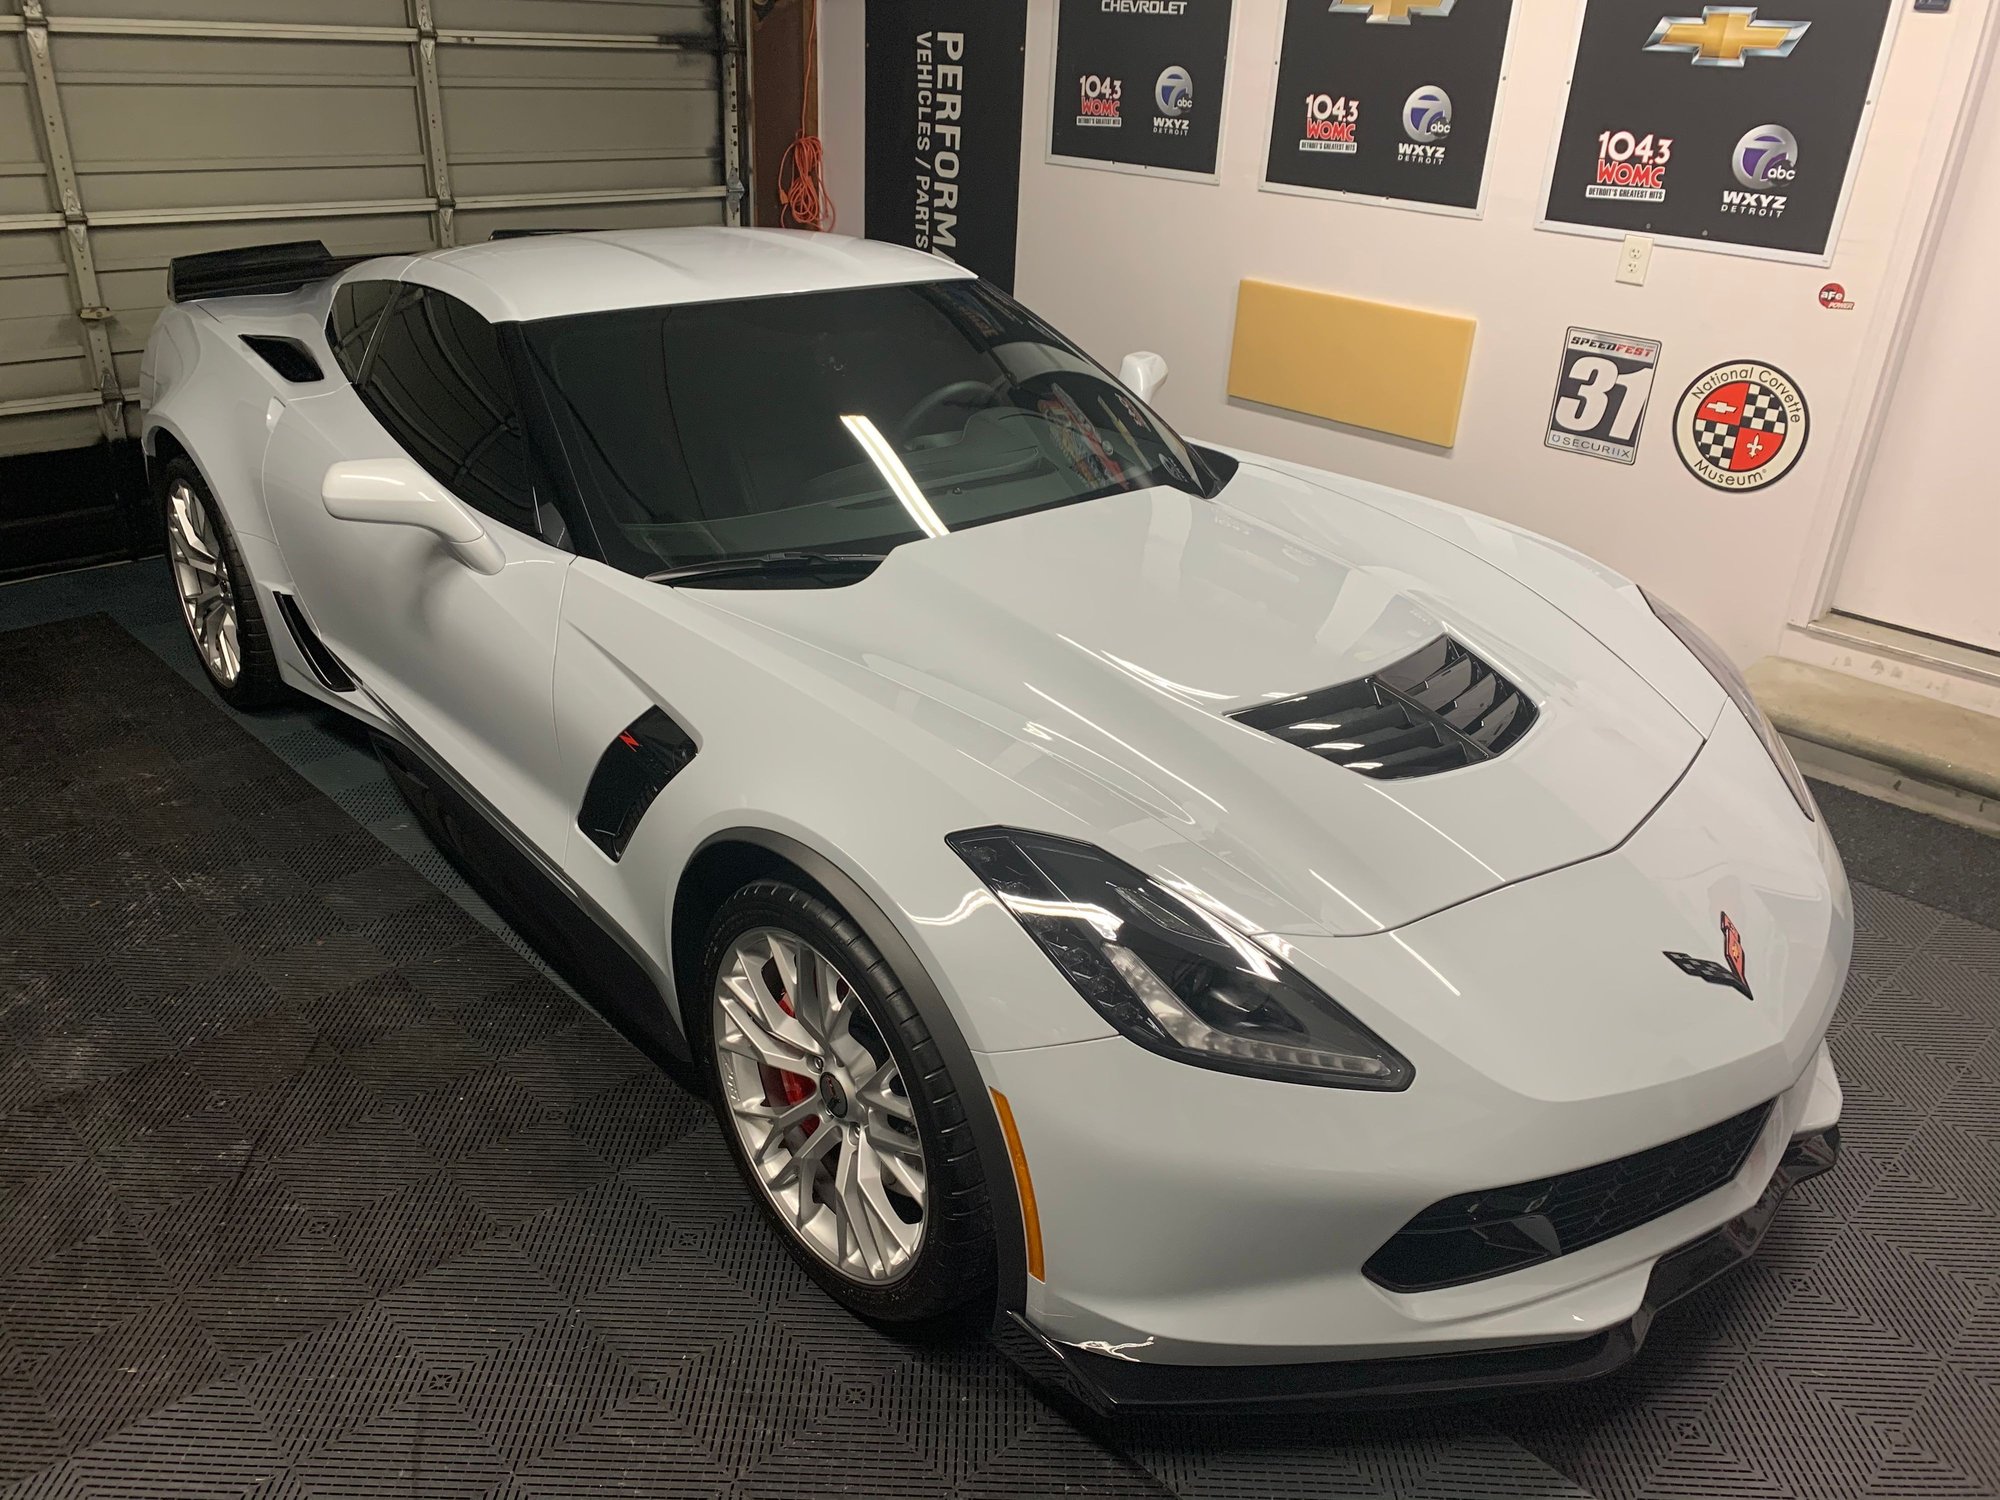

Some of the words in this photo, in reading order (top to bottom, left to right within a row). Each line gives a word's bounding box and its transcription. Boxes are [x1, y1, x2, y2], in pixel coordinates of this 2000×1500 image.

[1101, 0, 1187, 15] CHEVROLET
[916, 31, 932, 151] VEHICLES
[1079, 74, 1122, 99] 104.3
[1081, 96, 1120, 117] WOMC
[1177, 96, 1193, 108] abc
[1305, 93, 1360, 122] 104.3
[1153, 116, 1190, 130] WXYZ
[1153, 126, 1189, 136] DETROIT
[1306, 117, 1356, 142] WOMC
[1430, 120, 1451, 133] abc
[1398, 142, 1446, 159] WXYZ
[1598, 130, 1674, 165] 104.3
[915, 156, 931, 169] /
[1397, 154, 1444, 165] DETROIT
[1597, 158, 1666, 189] WOMC
[1767, 165, 1796, 180] abc
[1588, 187, 1618, 197] DETROIT'S
[1619, 188, 1648, 199] GREATEST
[1648, 190, 1664, 200] HITS
[1723, 190, 1788, 210] WXYZ
[915, 175, 931, 249] PARTS
[1720, 204, 1784, 219] DETROIT
[1820, 290, 1843, 301] aFe
[1570, 336, 1655, 358] SPEEDFEST
[1555, 355, 1654, 441] 31
[1691, 366, 1755, 400] National
[1758, 369, 1802, 424] Corvette
